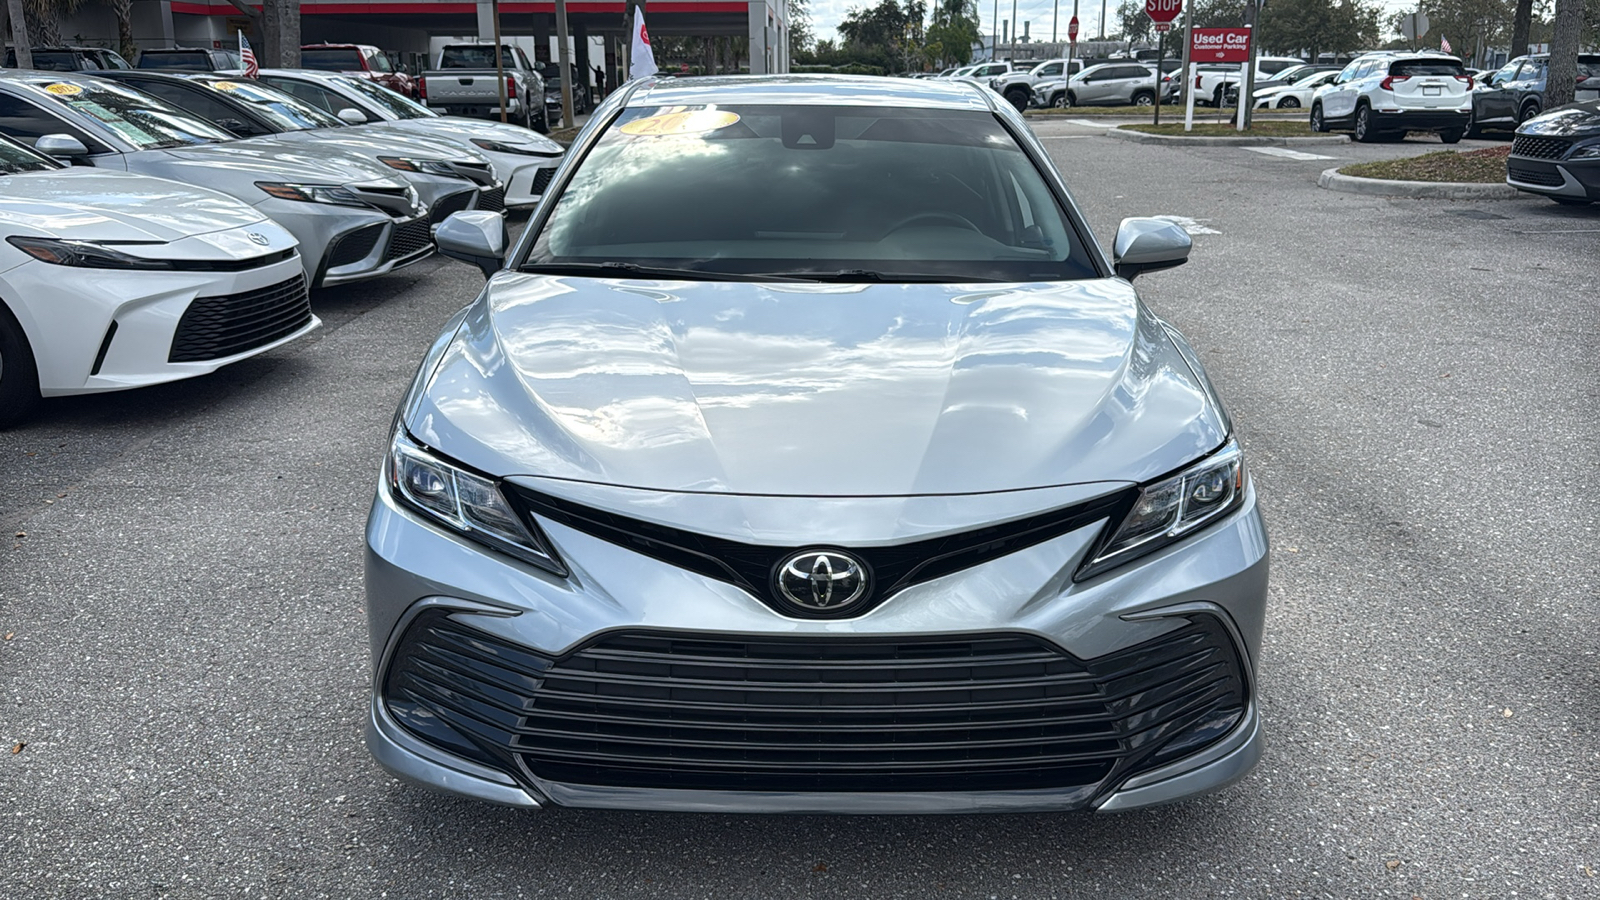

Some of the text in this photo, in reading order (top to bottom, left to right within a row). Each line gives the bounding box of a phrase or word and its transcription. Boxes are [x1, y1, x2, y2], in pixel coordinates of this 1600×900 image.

[1147, 0, 1181, 11] STOP
[1193, 33, 1248, 43] Used Car
